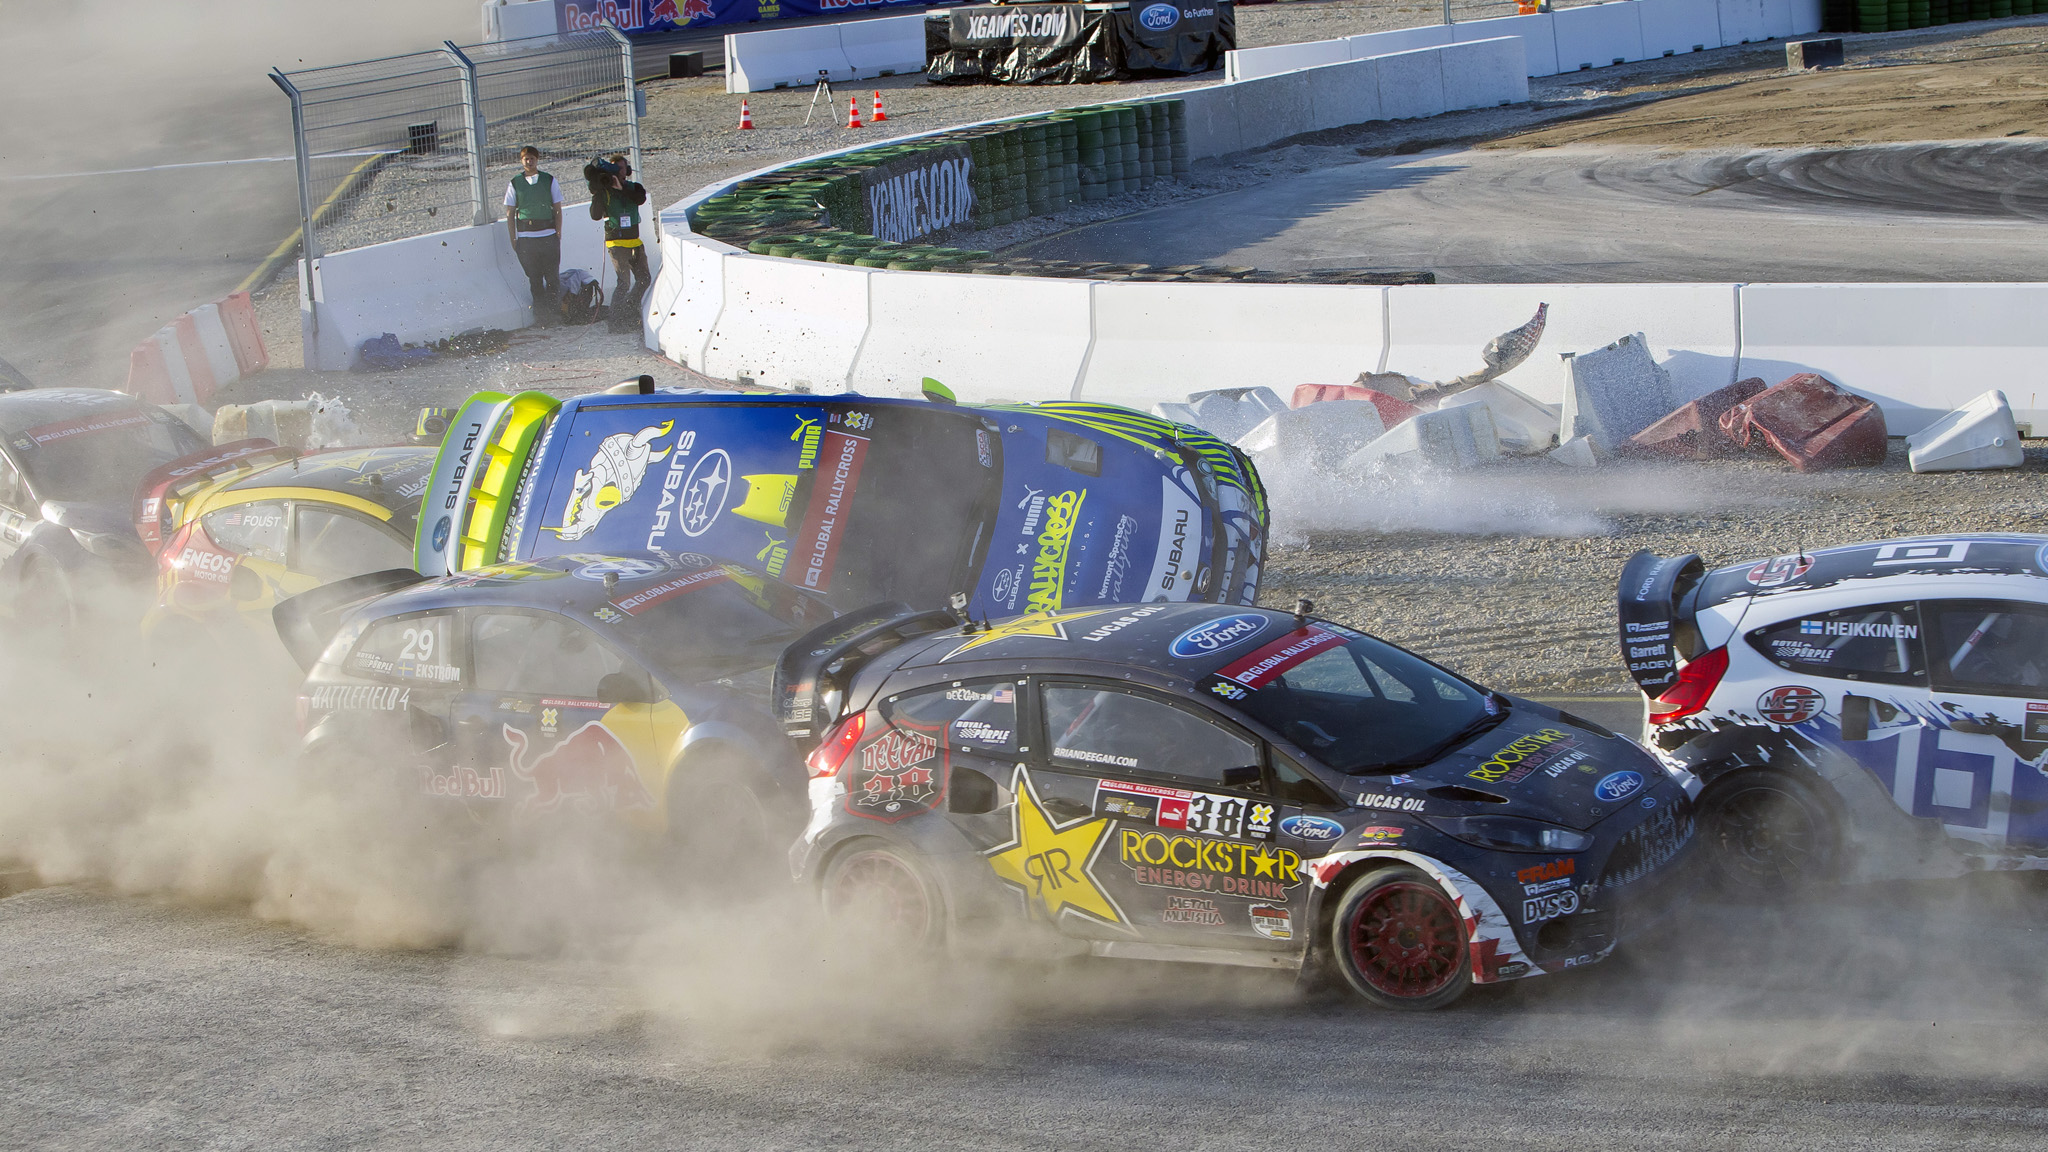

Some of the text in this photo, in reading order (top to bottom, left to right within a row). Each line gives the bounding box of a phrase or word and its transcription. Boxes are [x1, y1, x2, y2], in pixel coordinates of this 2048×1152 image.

[565, 0, 644, 36] Red Bull
[1183, 7, 1214, 19] Go Further
[966, 13, 1067, 39] XGAMES.COM
[51, 415, 148, 439] GLOBAL RALLYCROSS
[798, 425, 822, 469] PUMA
[445, 423, 482, 510] SUBARU
[647, 430, 696, 550] SUBARU
[810, 439, 858, 567] GLOBAL RALLYCROSS
[242, 515, 281, 528] FOUST
[181, 549, 234, 573] ENEOS
[1008, 564, 1024, 610] SUBARU
[1021, 496, 1045, 535] PUMA
[1098, 514, 1128, 599] Vermont SportsCar
[1112, 515, 1138, 603] rallying
[1162, 510, 1188, 590] SUBARU
[194, 570, 229, 583] MOTOR OIL
[634, 567, 731, 603] GLOBAL RALLYCROSS
[1068, 561, 1081, 593] TEAM
[1636, 577, 1655, 601] FORD
[1082, 605, 1166, 642] LUCAS OIL
[1187, 619, 1257, 650] Ford
[1826, 622, 1918, 639] HEIKKINEN
[400, 628, 434, 661] 29
[1250, 632, 1337, 675] GLOBAL RALLYCROSS
[1630, 644, 1666, 658] Garrett
[1793, 648, 1835, 659] PURPLE
[368, 660, 394, 671] PURPLE
[415, 664, 460, 682] EKSTRÖM
[1630, 660, 1674, 672] SADEV
[312, 686, 411, 711] BATTLEFIELD 4
[946, 689, 979, 701] DEEGAN
[1763, 695, 1817, 714] MSE
[784, 709, 812, 721] MSE
[955, 720, 983, 729] ROYAL
[974, 729, 1011, 741] PURPLE
[862, 729, 937, 771] DEEGAN
[1053, 747, 1138, 767] BRIANDEEGAN.COM
[1503, 752, 1548, 782] ENERGY
[1544, 756, 1577, 778] LUCAS
[1569, 750, 1590, 761] OIL
[420, 765, 505, 798] Red Bull
[1109, 781, 1134, 790] GLOBAL
[1135, 785, 1175, 796] RALLYCROSS
[1602, 775, 1639, 798] Ford
[1356, 793, 1427, 811] LUCAS OIL
[1187, 795, 1243, 835] 38
[1291, 819, 1333, 839] Ford
[1136, 865, 1286, 900] ENERGY DRINK
[1517, 858, 1575, 884] FRAM
[1168, 896, 1219, 911] METAL
[1523, 893, 1561, 924] DVS
[1163, 910, 1225, 925] MULISHA
